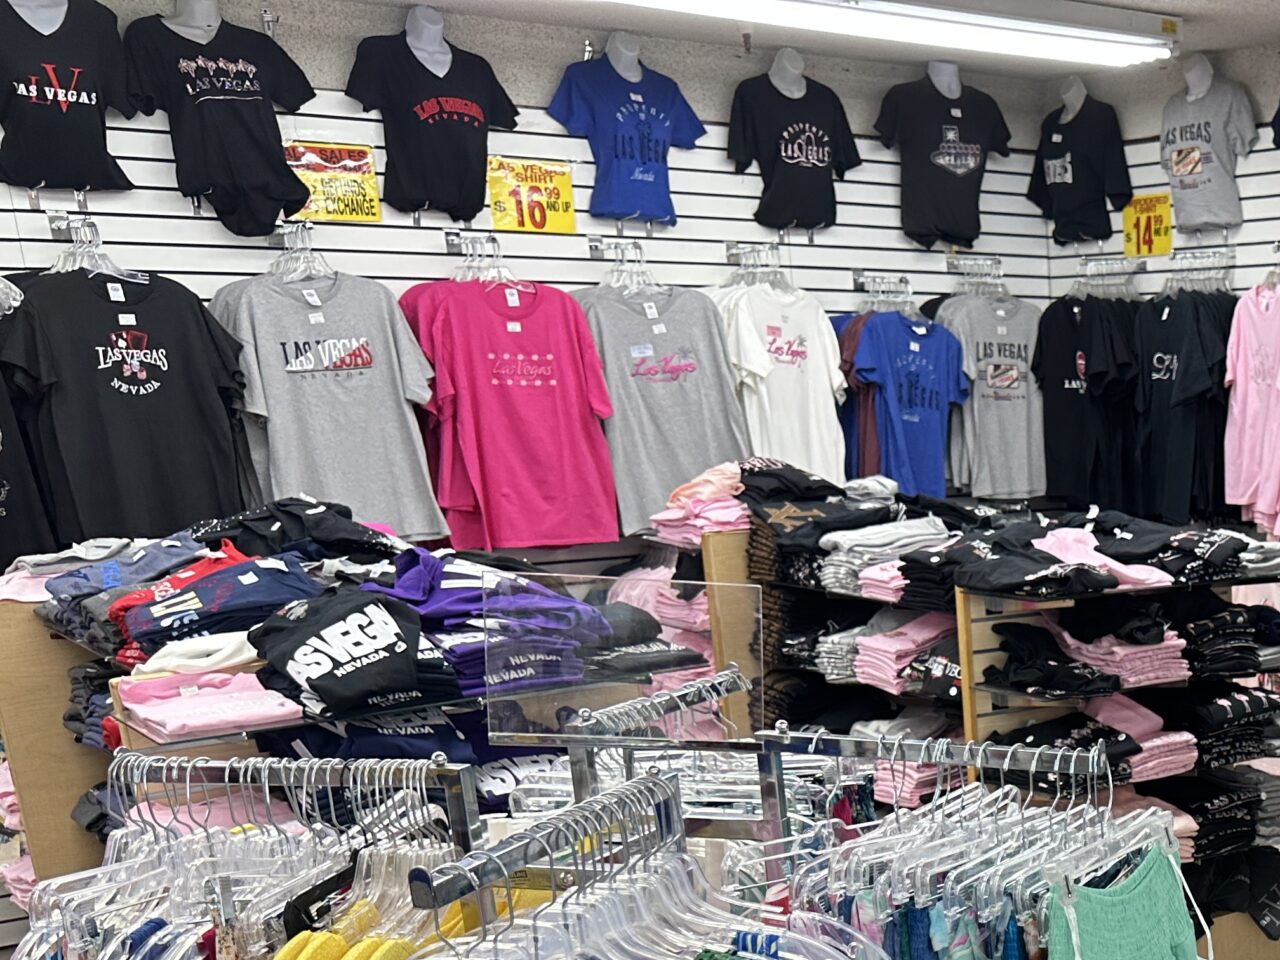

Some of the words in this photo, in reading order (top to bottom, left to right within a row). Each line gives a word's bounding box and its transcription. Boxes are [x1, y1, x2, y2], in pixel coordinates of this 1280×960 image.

[44, 86, 97, 105] VEGAS
[185, 78, 211, 95] LAS
[212, 77, 261, 92] VEGAS
[508, 184, 547, 230] 16
[1133, 215, 1154, 256] 14
[95, 346, 122, 370] LAS
[121, 348, 169, 371] VEGAS
[279, 340, 315, 371] LAS
[314, 337, 373, 371] VEGAS
[975, 340, 994, 363] LAS
[996, 341, 1029, 365] VEGAS
[110, 377, 161, 395] NEVADA
[305, 602, 406, 665] VEGA
[333, 649, 390, 678] NEVADA
[416, 649, 443, 661] ADA
